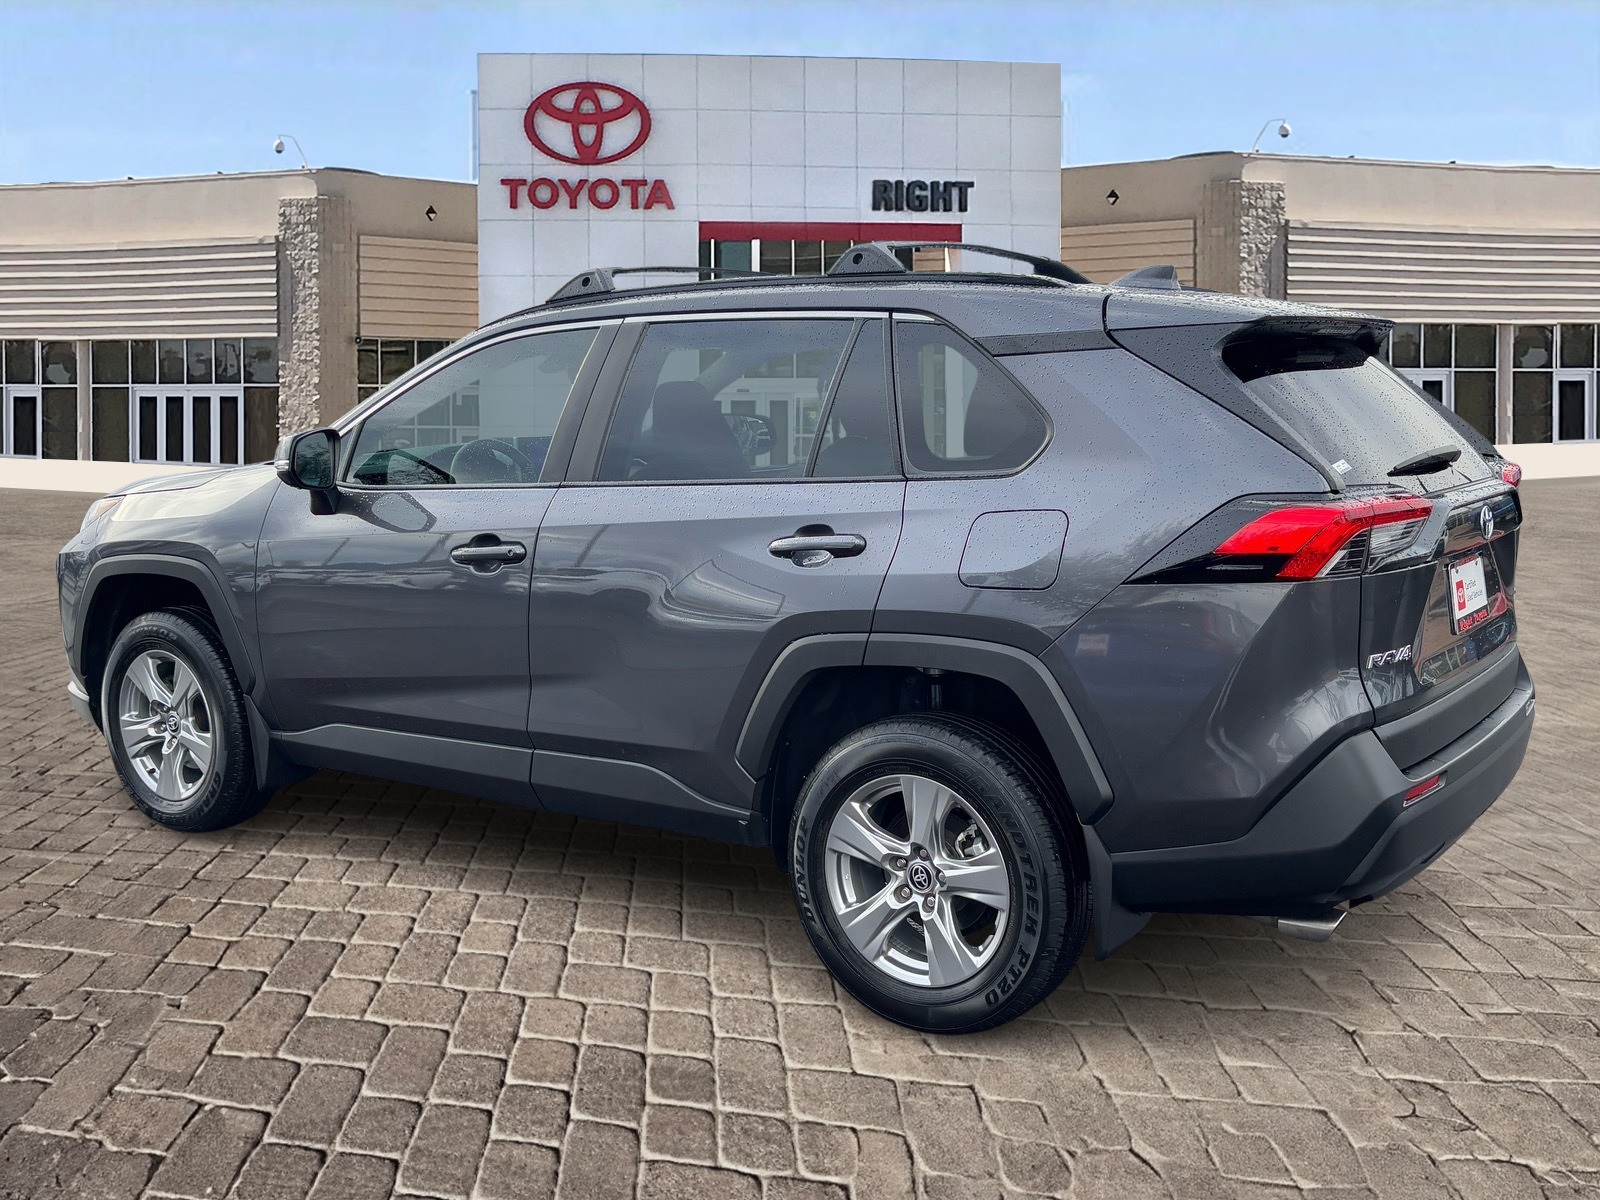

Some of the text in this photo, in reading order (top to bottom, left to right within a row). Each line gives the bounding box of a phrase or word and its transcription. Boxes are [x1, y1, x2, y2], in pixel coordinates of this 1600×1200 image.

[500, 178, 675, 209] TOYOTA
[872, 180, 974, 212] RIGHT
[1366, 644, 1412, 669] RAV4
[795, 815, 817, 924] DUNLOP
[951, 762, 1040, 1008] GRANDTREK PT20
